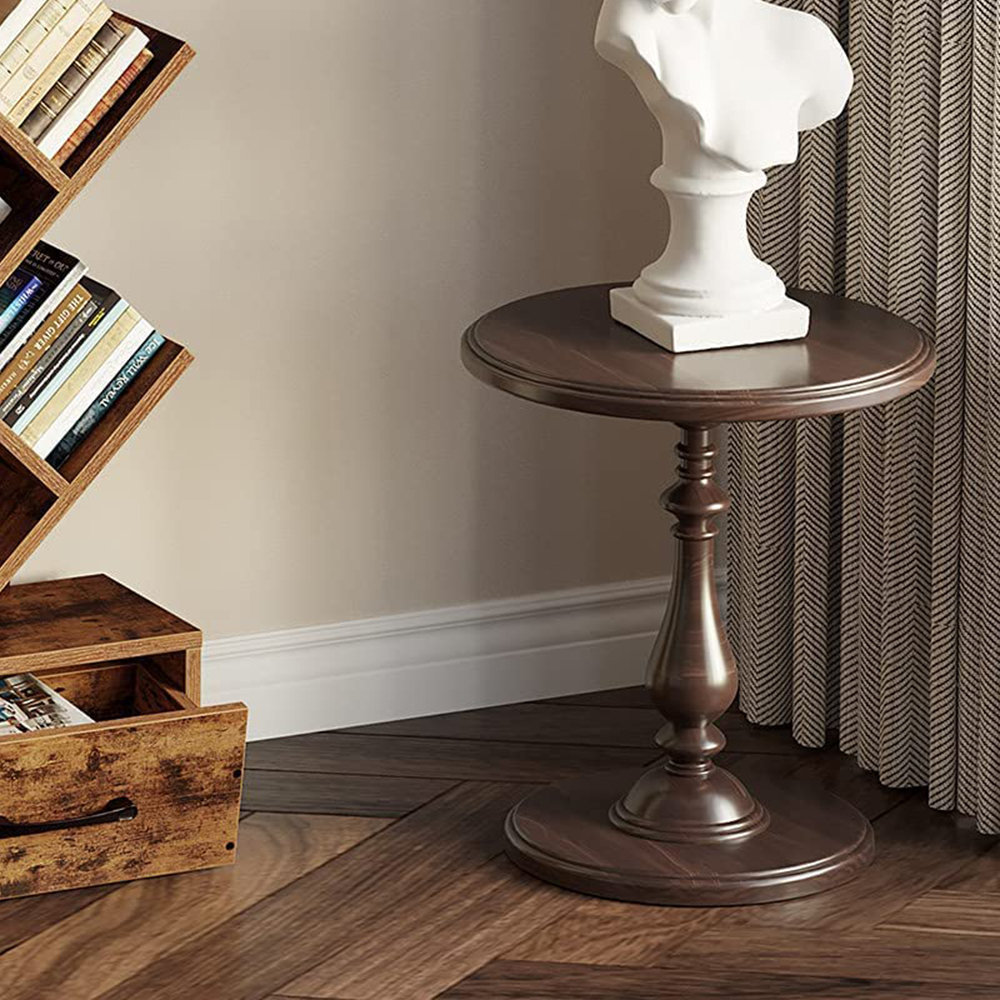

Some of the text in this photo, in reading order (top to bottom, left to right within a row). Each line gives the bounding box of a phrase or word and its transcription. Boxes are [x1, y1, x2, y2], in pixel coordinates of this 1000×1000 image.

[66, 293, 83, 311] THE
[51, 308, 70, 329] GIFT
[33, 325, 56, 350] GIVER
